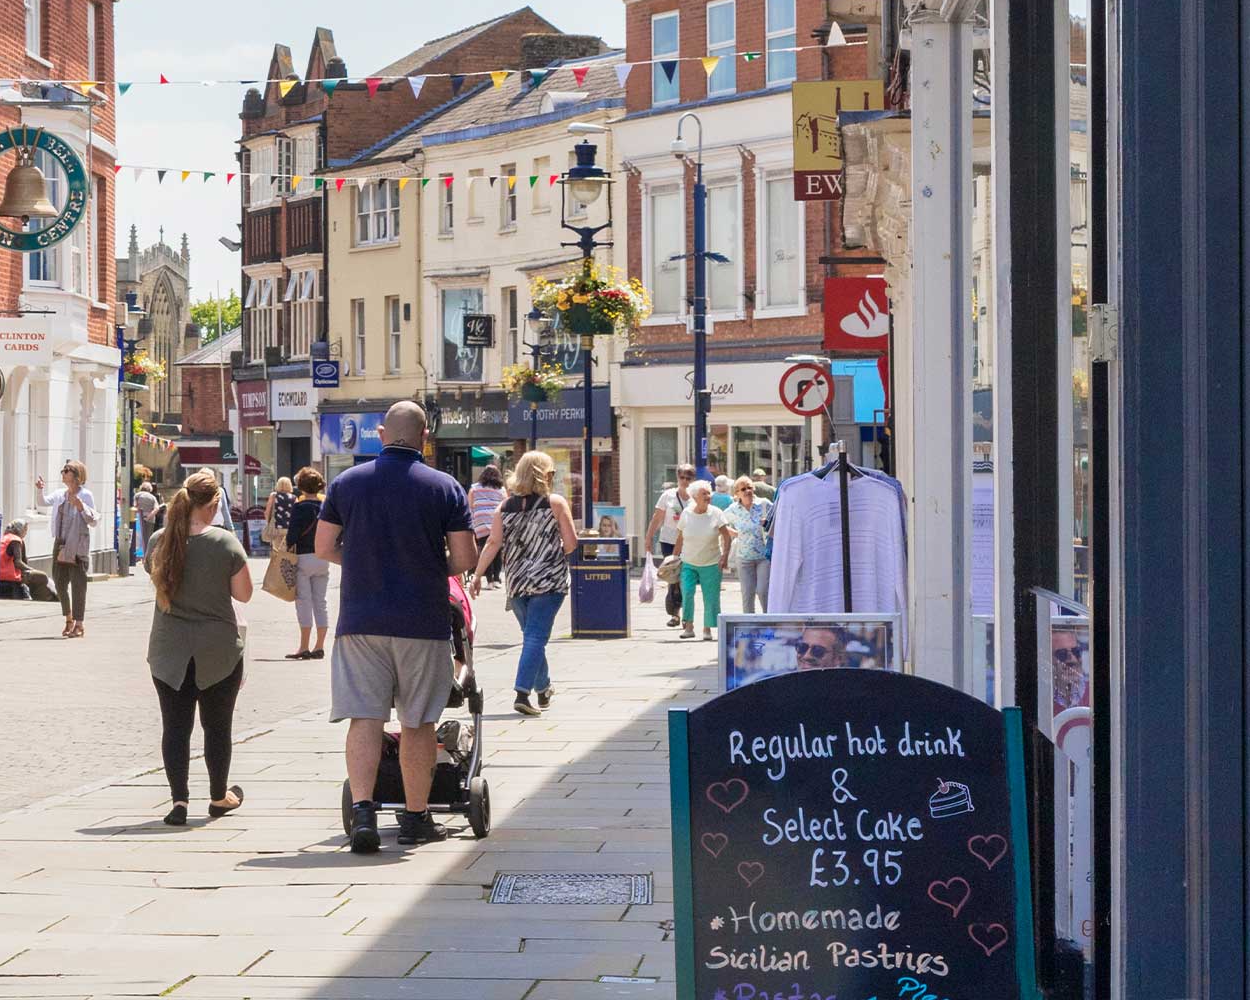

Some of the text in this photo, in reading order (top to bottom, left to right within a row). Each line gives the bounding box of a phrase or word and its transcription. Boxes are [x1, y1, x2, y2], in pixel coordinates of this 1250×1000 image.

[37, 190, 84, 246] CENTRE
[0, 333, 46, 341] CLINTON
[4, 343, 39, 351] CARDS
[242, 392, 266, 408] TIMPSON
[561, 407, 585, 420] PERKI
[585, 573, 611, 581] LITTER
[729, 721, 965, 781] Regular hot drink
[831, 767, 858, 804] &
[762, 807, 924, 846] Select Cake
[810, 847, 903, 888] £3.95
[705, 941, 949, 977] Sicilian Pastries
